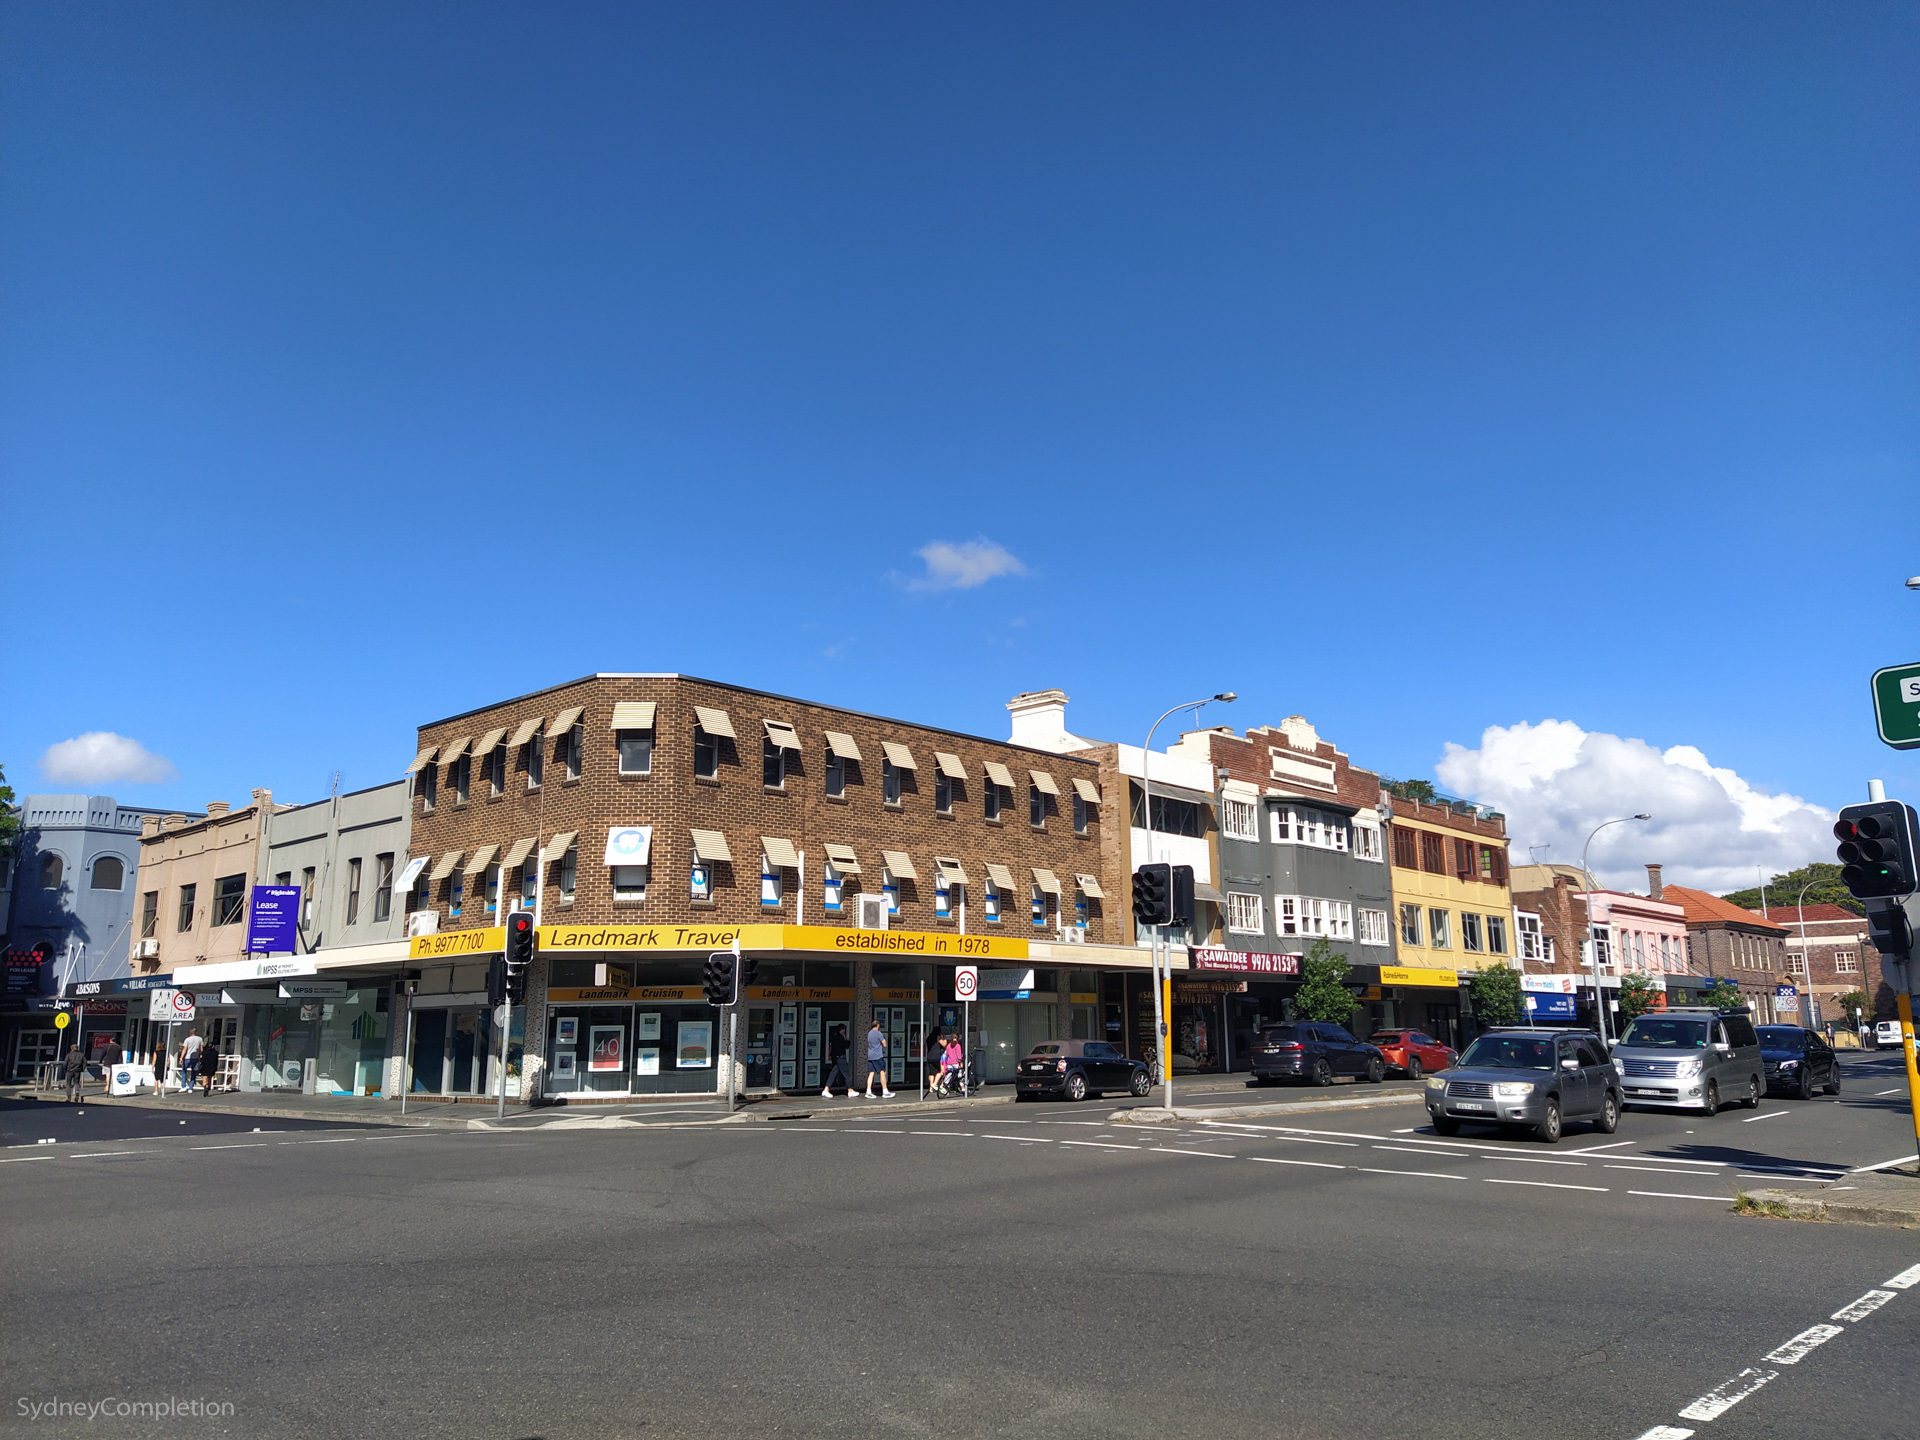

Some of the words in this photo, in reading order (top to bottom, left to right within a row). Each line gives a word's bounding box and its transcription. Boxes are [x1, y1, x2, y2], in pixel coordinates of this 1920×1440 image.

[256, 901, 279, 909] Lease
[550, 929, 660, 946] Landmark
[674, 928, 741, 946] Travel
[417, 937, 433, 954] Ph.
[434, 934, 459, 953] 9977
[459, 932, 485, 950] 7100
[835, 932, 926, 950] established
[934, 936, 948, 952] in
[956, 937, 991, 954] 1978
[1203, 949, 1248, 964] SAWATDEE
[1251, 953, 1272, 972] 9976
[1272, 954, 1292, 972] 2153
[263, 964, 278, 975] MPSS
[129, 979, 147, 990] VILLAGE
[959, 977, 973, 989] 50
[982, 979, 1005, 987] DENTAL
[578, 989, 630, 1000] Landmark
[641, 988, 684, 999] Cruising
[762, 988, 801, 998] Landmark
[808, 989, 832, 998] Travel
[888, 990, 904, 999] since
[904, 990, 920, 999] 1978
[53, 999, 71, 1010] Love
[177, 996, 192, 1006] 30
[172, 1012, 193, 1020] AREA
[594, 1037, 620, 1057] 40
